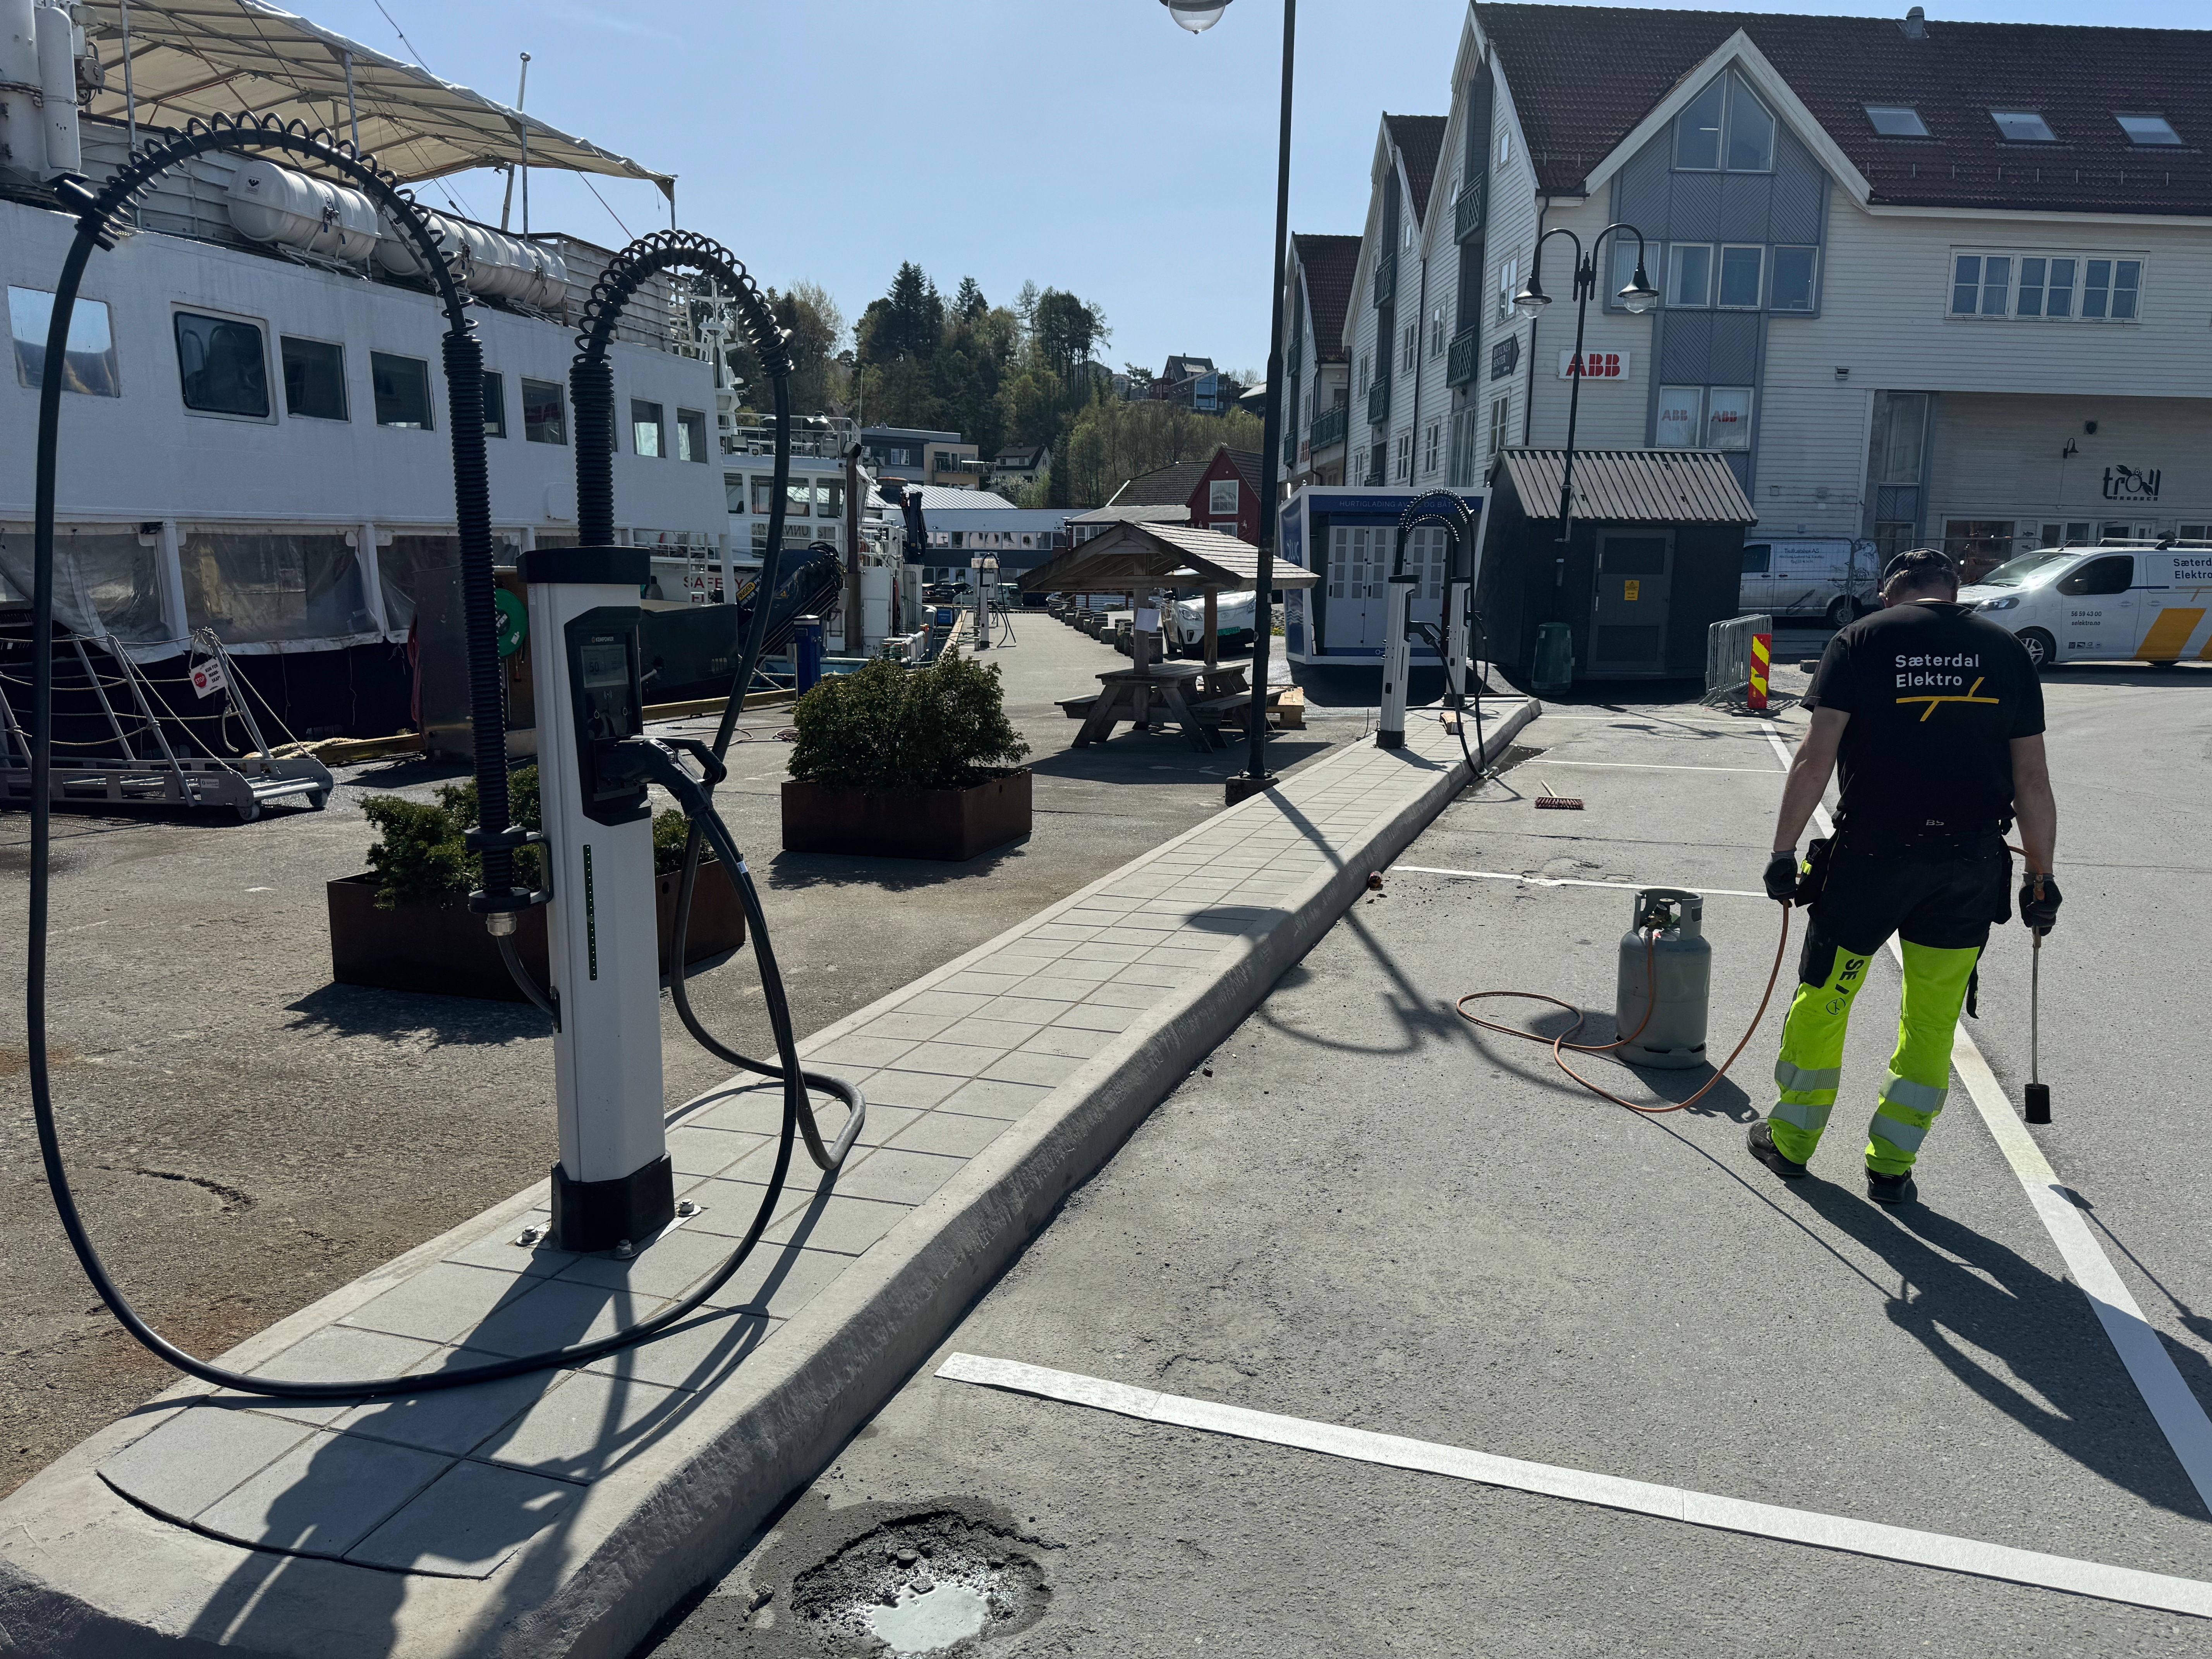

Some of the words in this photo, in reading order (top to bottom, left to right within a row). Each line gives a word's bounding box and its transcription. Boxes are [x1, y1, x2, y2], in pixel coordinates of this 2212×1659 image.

[1565, 353, 1620, 377] ABB
[1662, 409, 1688, 421] ABB
[1711, 410, 1737, 422] ABB
[2173, 558, 2212, 567] Sæterd
[2175, 570, 2212, 579] Elektro
[684, 576, 744, 589] SAFEY
[1896, 653, 1979, 668] Sæterdal
[195, 676, 205, 685] STOP
[1896, 672, 1963, 688] Elektro
